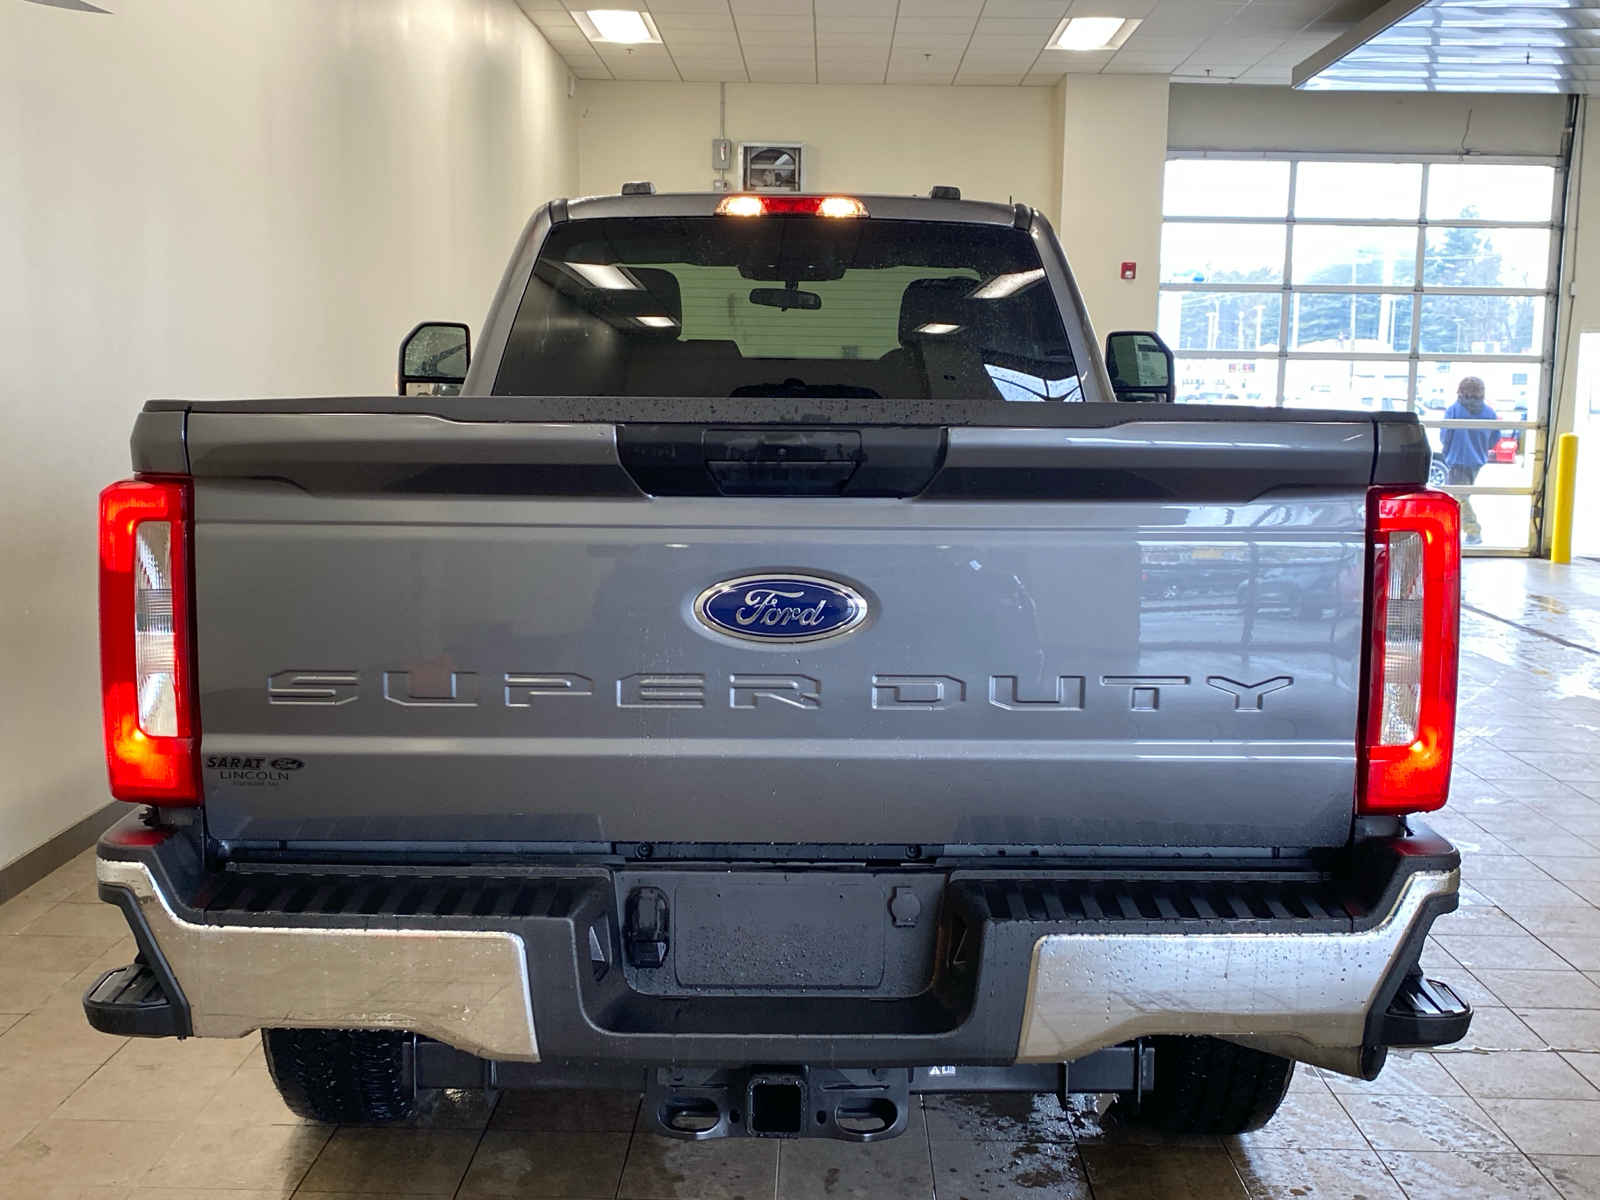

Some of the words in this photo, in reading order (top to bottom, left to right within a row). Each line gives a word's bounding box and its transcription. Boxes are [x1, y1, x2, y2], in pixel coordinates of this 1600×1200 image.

[736, 589, 825, 626] Ford
[267, 669, 820, 711] SUPER
[870, 674, 1294, 712] DUTY
[206, 756, 266, 769] SARAT
[275, 759, 298, 769] Ford
[220, 771, 289, 780] LINCOLN
